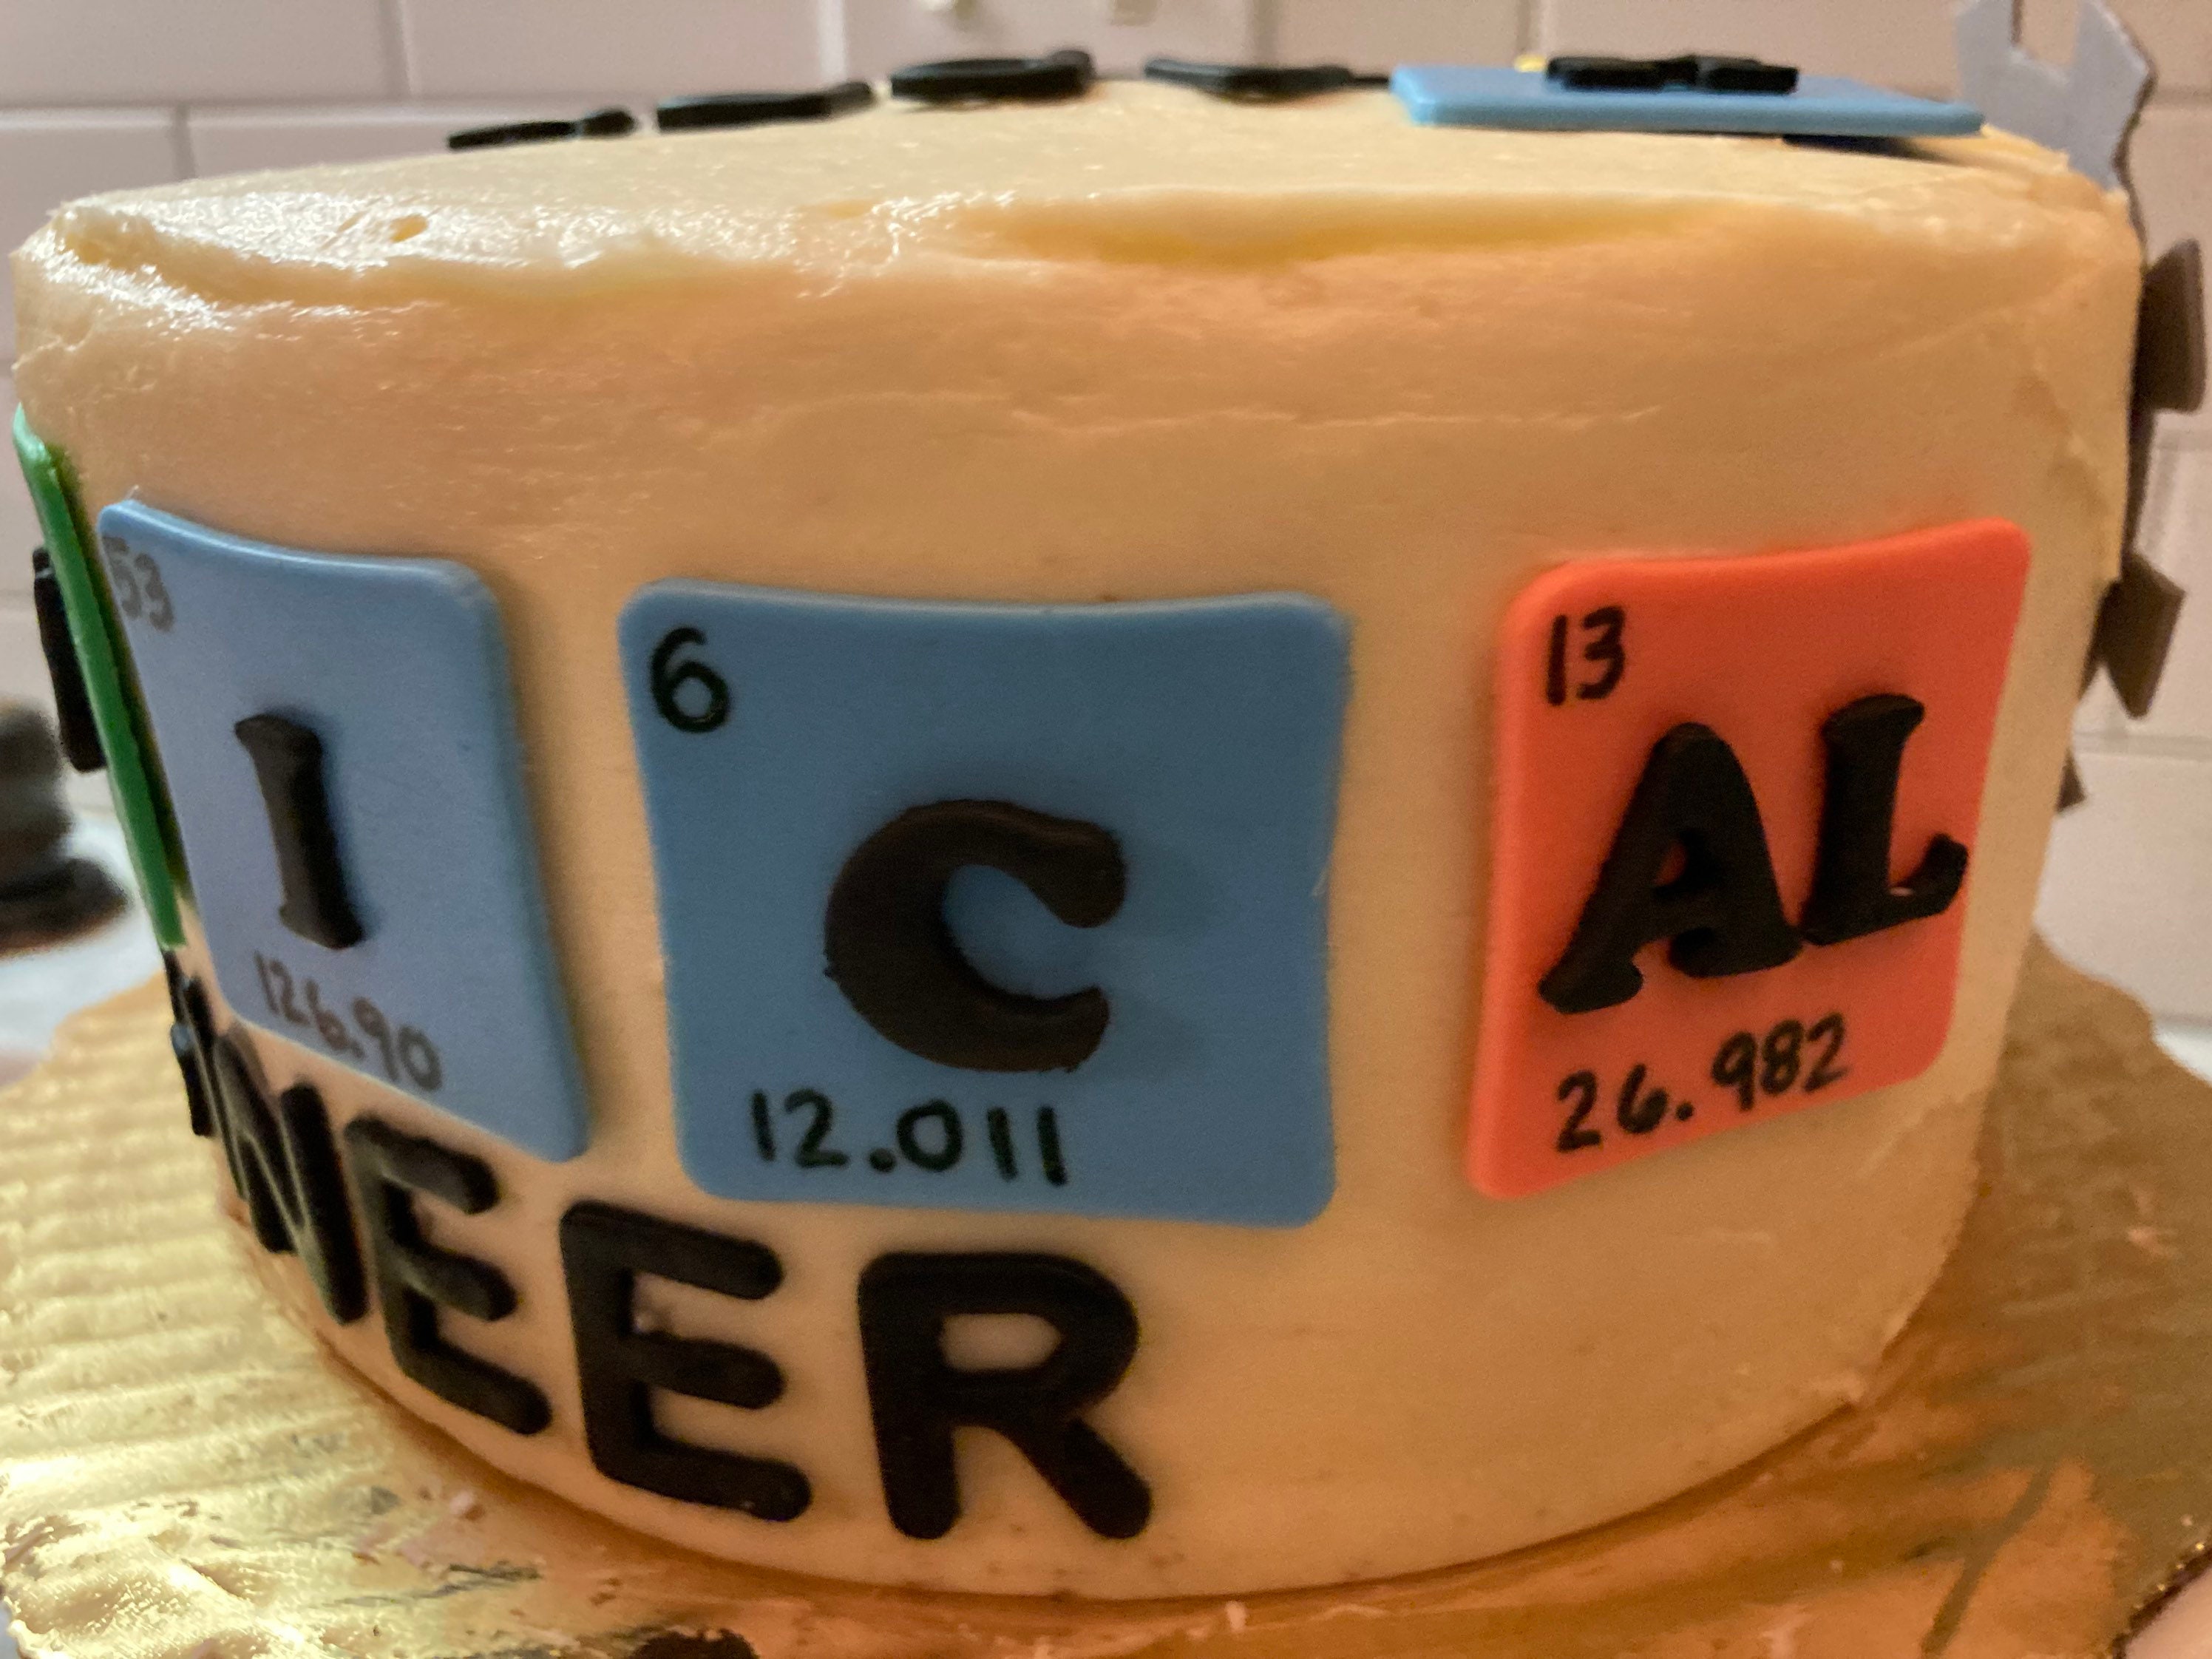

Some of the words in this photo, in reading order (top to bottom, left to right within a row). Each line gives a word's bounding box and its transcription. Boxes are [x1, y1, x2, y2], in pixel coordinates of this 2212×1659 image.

[102, 535, 174, 634] 53
[650, 626, 730, 733] 6
[1544, 606, 1625, 705] 13
[235, 713, 367, 949] I
[1538, 693, 1968, 1015] AL
[824, 799, 1128, 1073] C
[254, 951, 442, 1091] 126.90
[1555, 1012, 1854, 1154] 26.982
[750, 1088, 1068, 1186] 12.011
